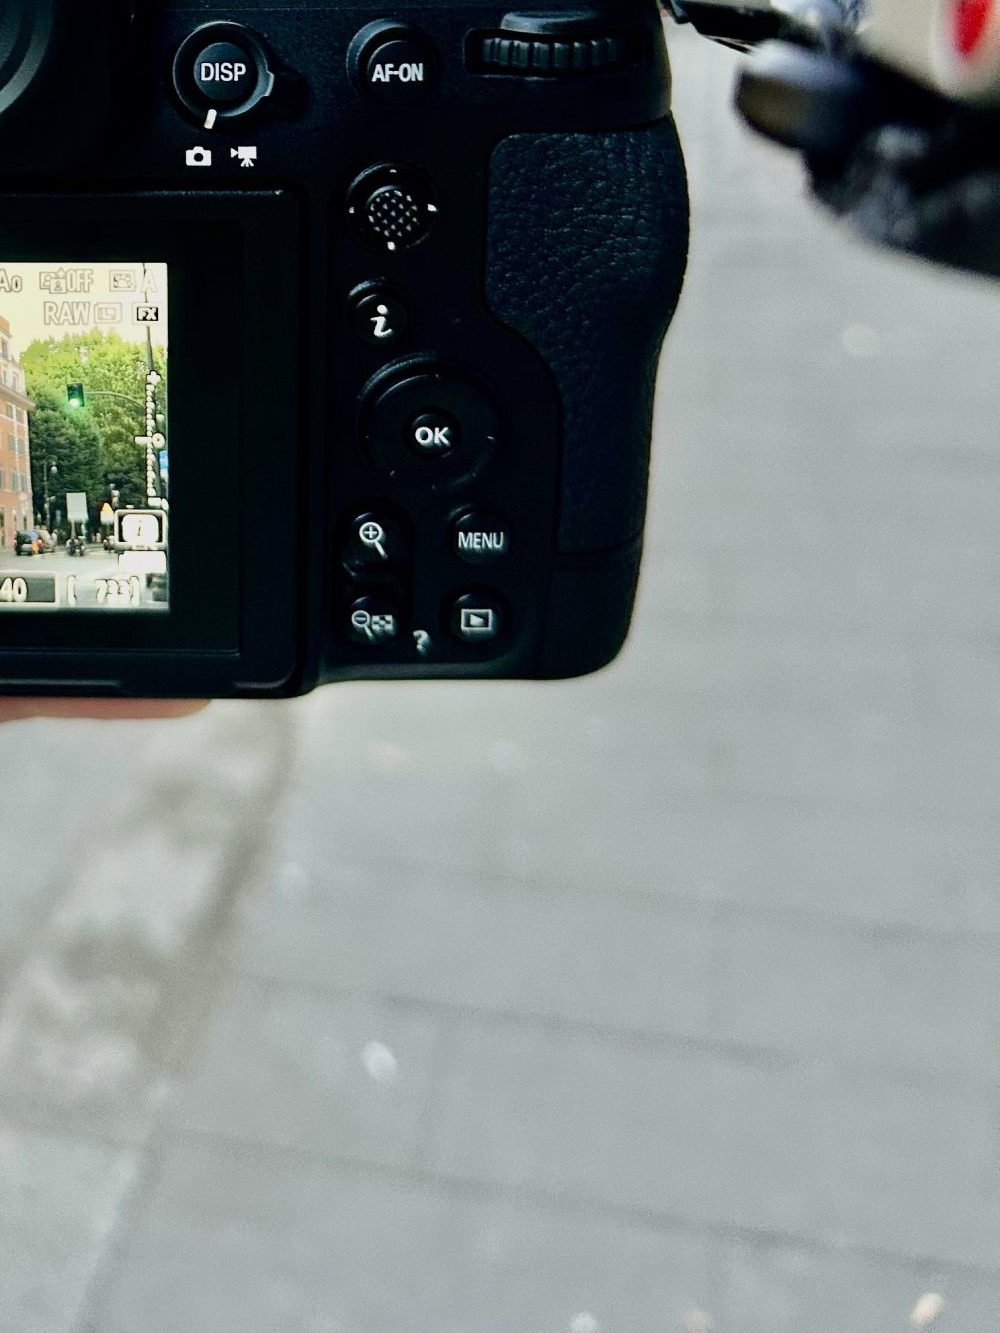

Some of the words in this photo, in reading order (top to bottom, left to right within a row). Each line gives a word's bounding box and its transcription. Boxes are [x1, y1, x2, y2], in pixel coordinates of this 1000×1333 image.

[200, 62, 247, 82] DISP
[371, 62, 424, 82] AF-ON
[66, 268, 94, 293] OFF
[43, 300, 91, 326] RAW
[137, 307, 158, 321] FX
[370, 304, 393, 338] i
[414, 426, 451, 448] OK
[457, 531, 504, 550] MENU
[412, 629, 431, 654] ?
